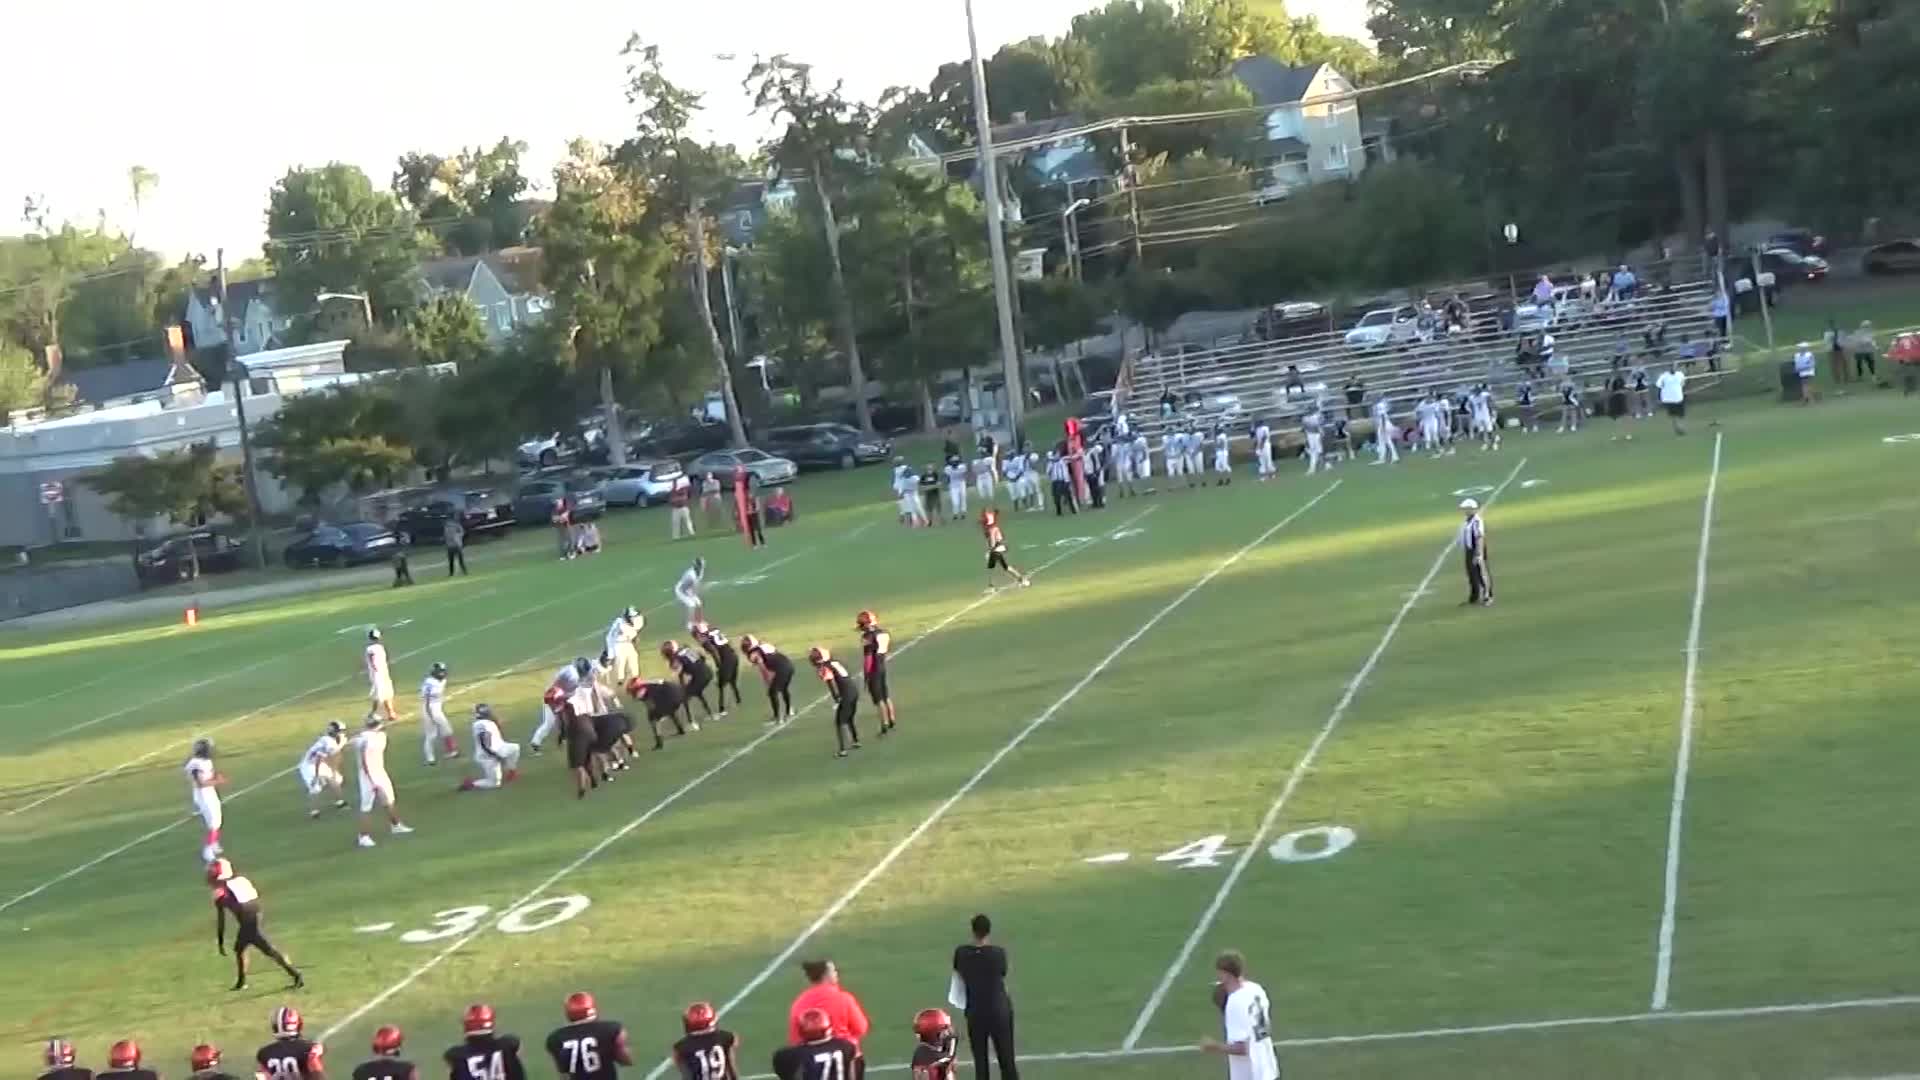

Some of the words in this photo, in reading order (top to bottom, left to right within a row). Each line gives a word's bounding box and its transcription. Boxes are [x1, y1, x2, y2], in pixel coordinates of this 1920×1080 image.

[1155, 825, 1356, 868] 40
[400, 895, 591, 943] 30
[467, 1050, 506, 1080] 54
[563, 1036, 601, 1074] 76
[695, 1045, 727, 1080] 19
[814, 1050, 845, 1080] 71
